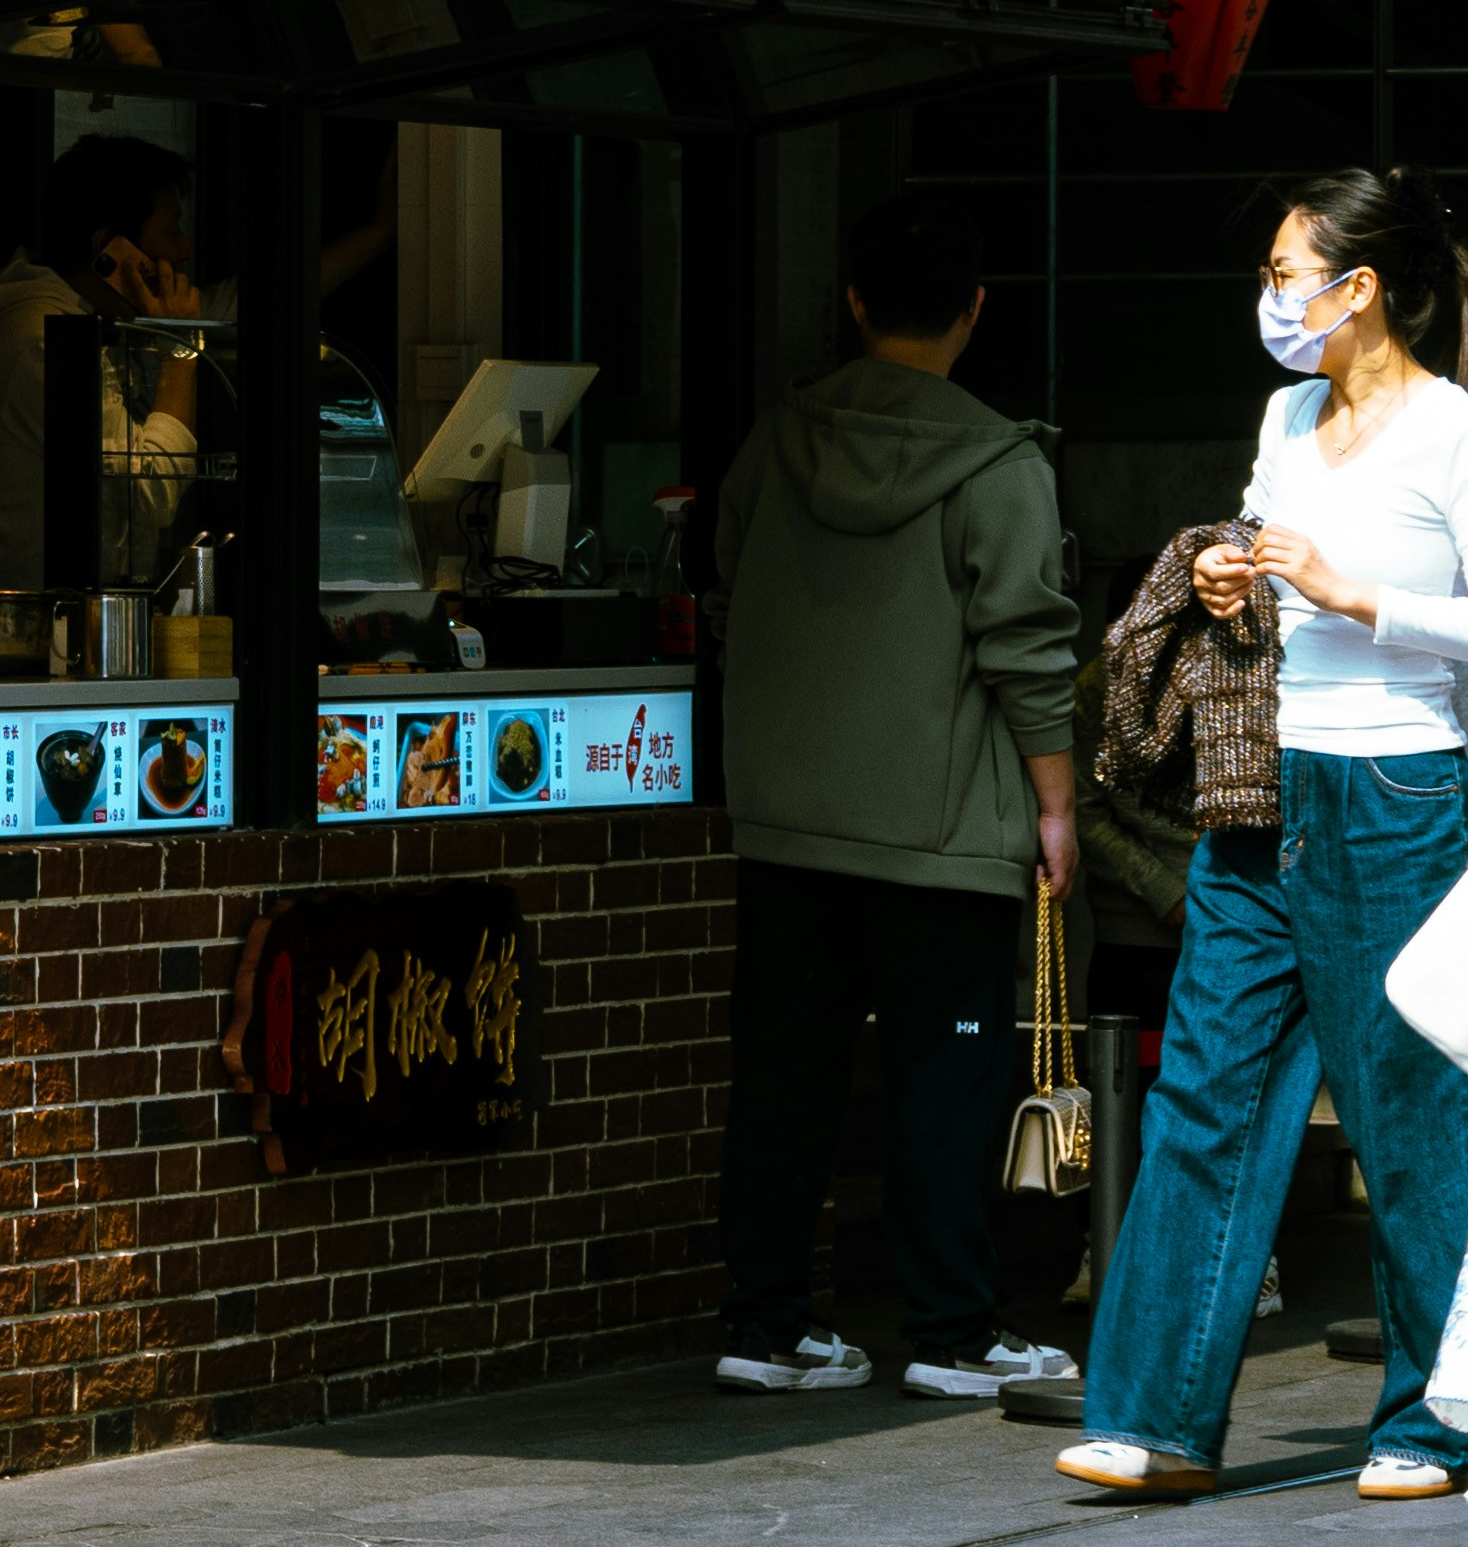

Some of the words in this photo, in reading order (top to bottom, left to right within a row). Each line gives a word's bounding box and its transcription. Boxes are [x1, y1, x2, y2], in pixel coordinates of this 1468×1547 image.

[586, 742, 623, 772] 源自于
[648, 731, 674, 759] 地方
[642, 763, 681, 791] 名小吃
